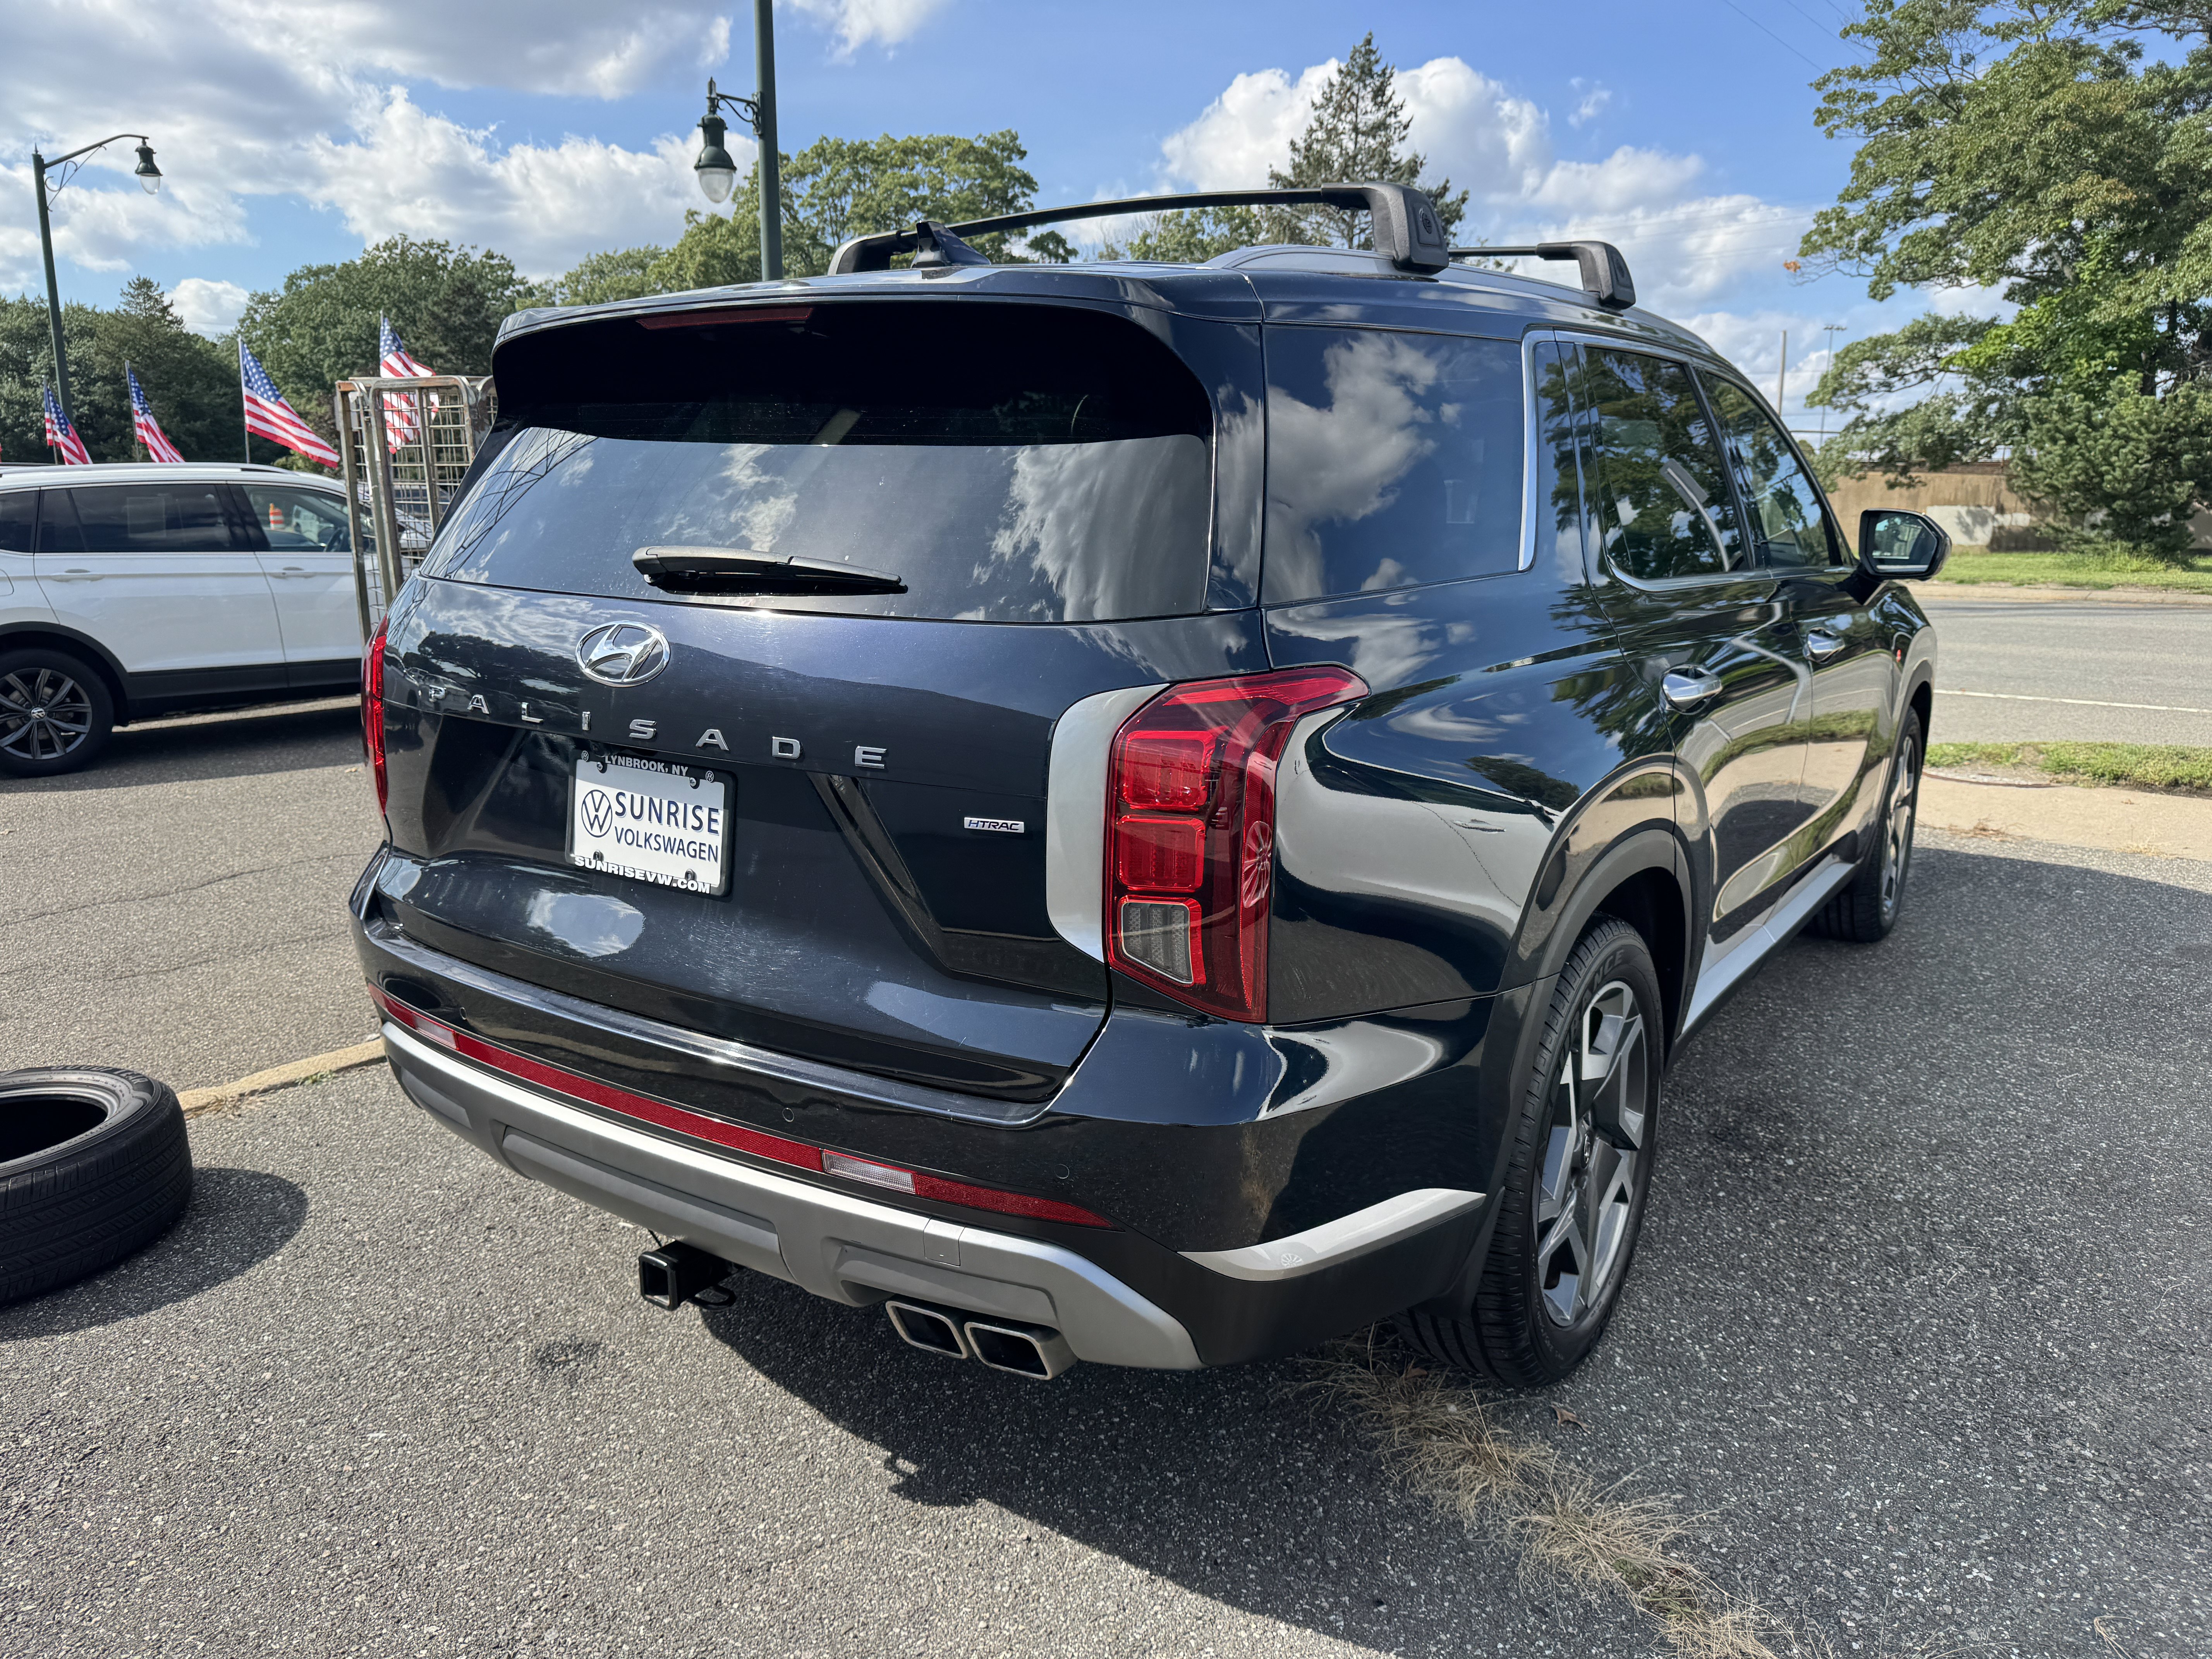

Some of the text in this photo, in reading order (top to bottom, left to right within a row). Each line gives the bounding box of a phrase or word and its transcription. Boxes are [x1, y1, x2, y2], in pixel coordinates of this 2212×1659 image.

[429, 684, 888, 769] PALISADE
[605, 755, 688, 776] LYNBROOK, NY
[615, 792, 720, 836] SUNRISE
[968, 820, 1019, 831] HTRAC
[615, 826, 718, 863] VOLKSWAGEN
[574, 856, 711, 894] SUNRISEVW.COM
